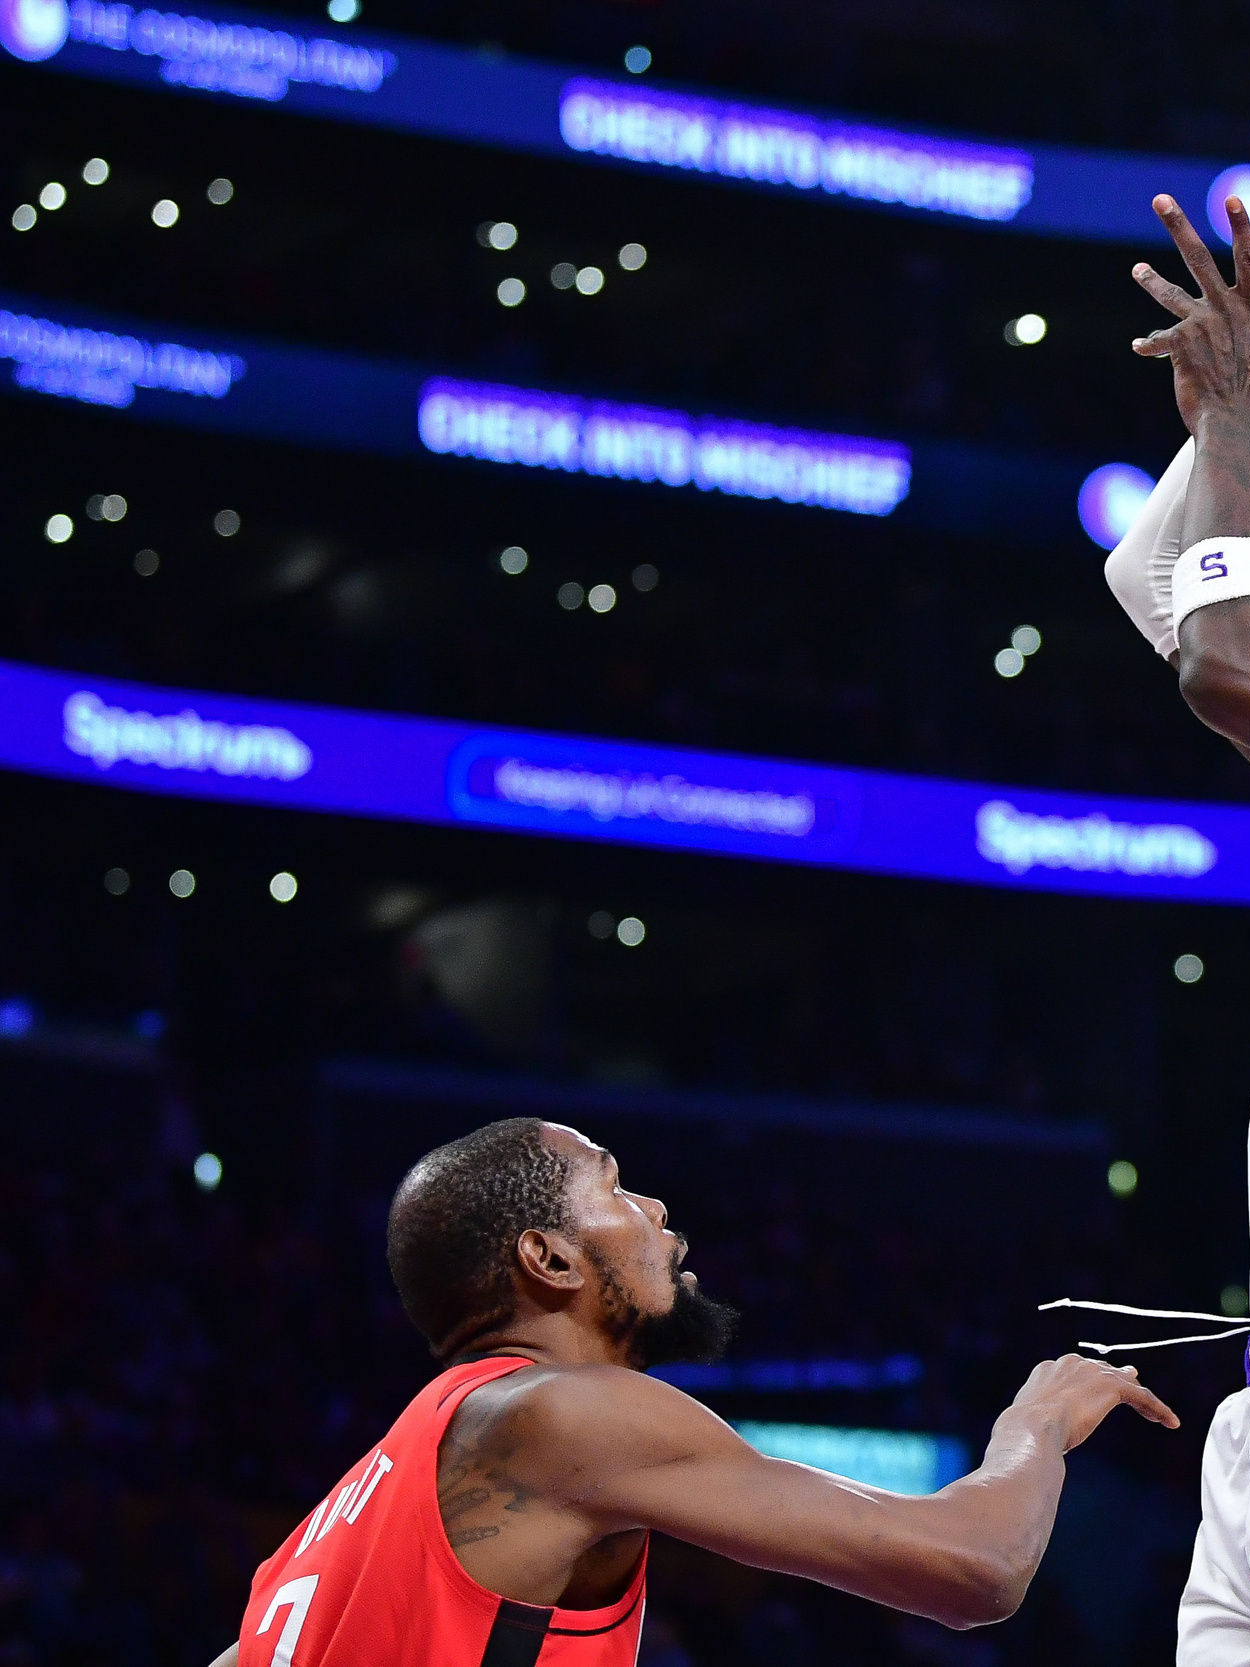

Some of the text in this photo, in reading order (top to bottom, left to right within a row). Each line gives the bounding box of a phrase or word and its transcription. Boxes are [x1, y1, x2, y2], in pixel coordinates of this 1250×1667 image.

[561, 80, 1033, 220] CHECK INTO MISCHIEF
[418, 378, 912, 516] CHECK INTO MISCHIEF
[63, 691, 312, 782] Spectrum
[974, 800, 1217, 876] Spectrum
